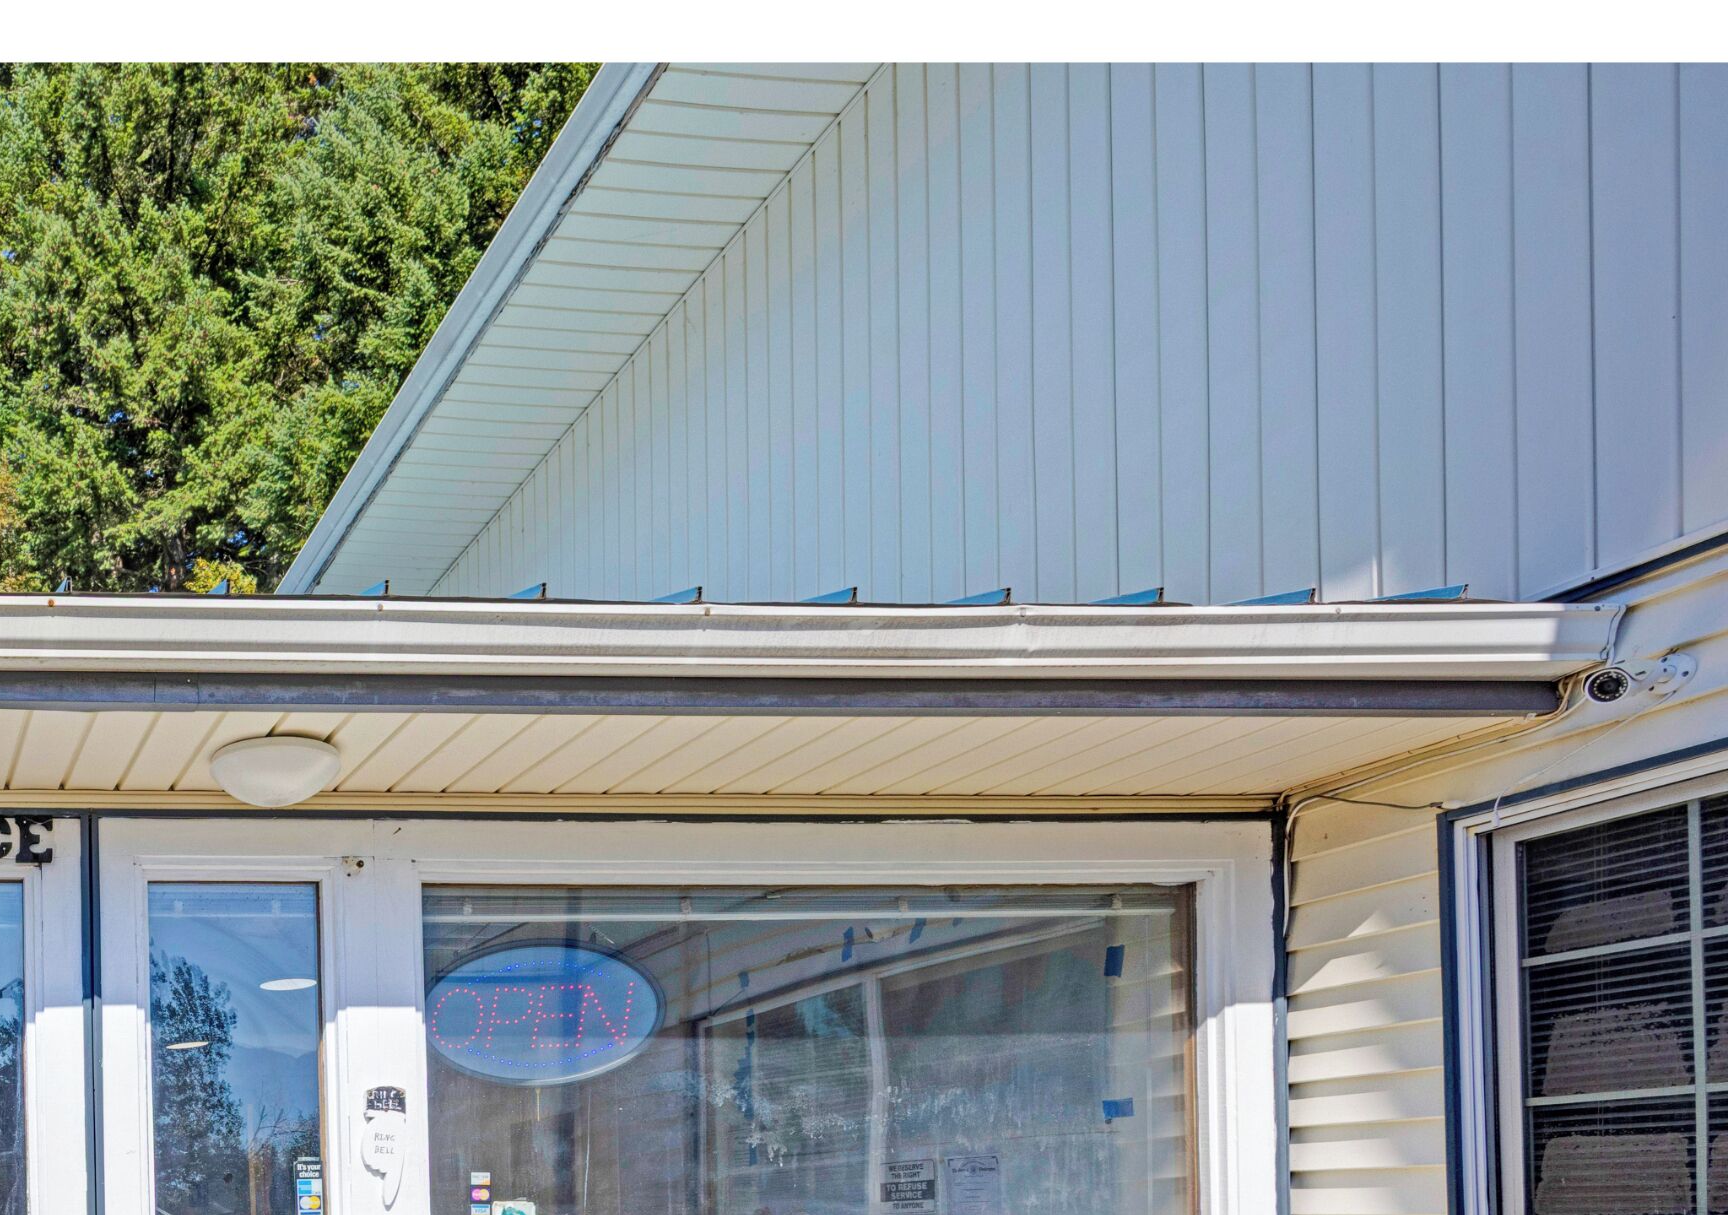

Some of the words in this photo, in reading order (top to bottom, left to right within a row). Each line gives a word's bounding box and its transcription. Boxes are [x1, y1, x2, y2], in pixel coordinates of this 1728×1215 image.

[432, 981, 636, 1049] OPEN
[898, 1182, 928, 1191] REFUSE
[891, 1190, 922, 1200] SERVICE
